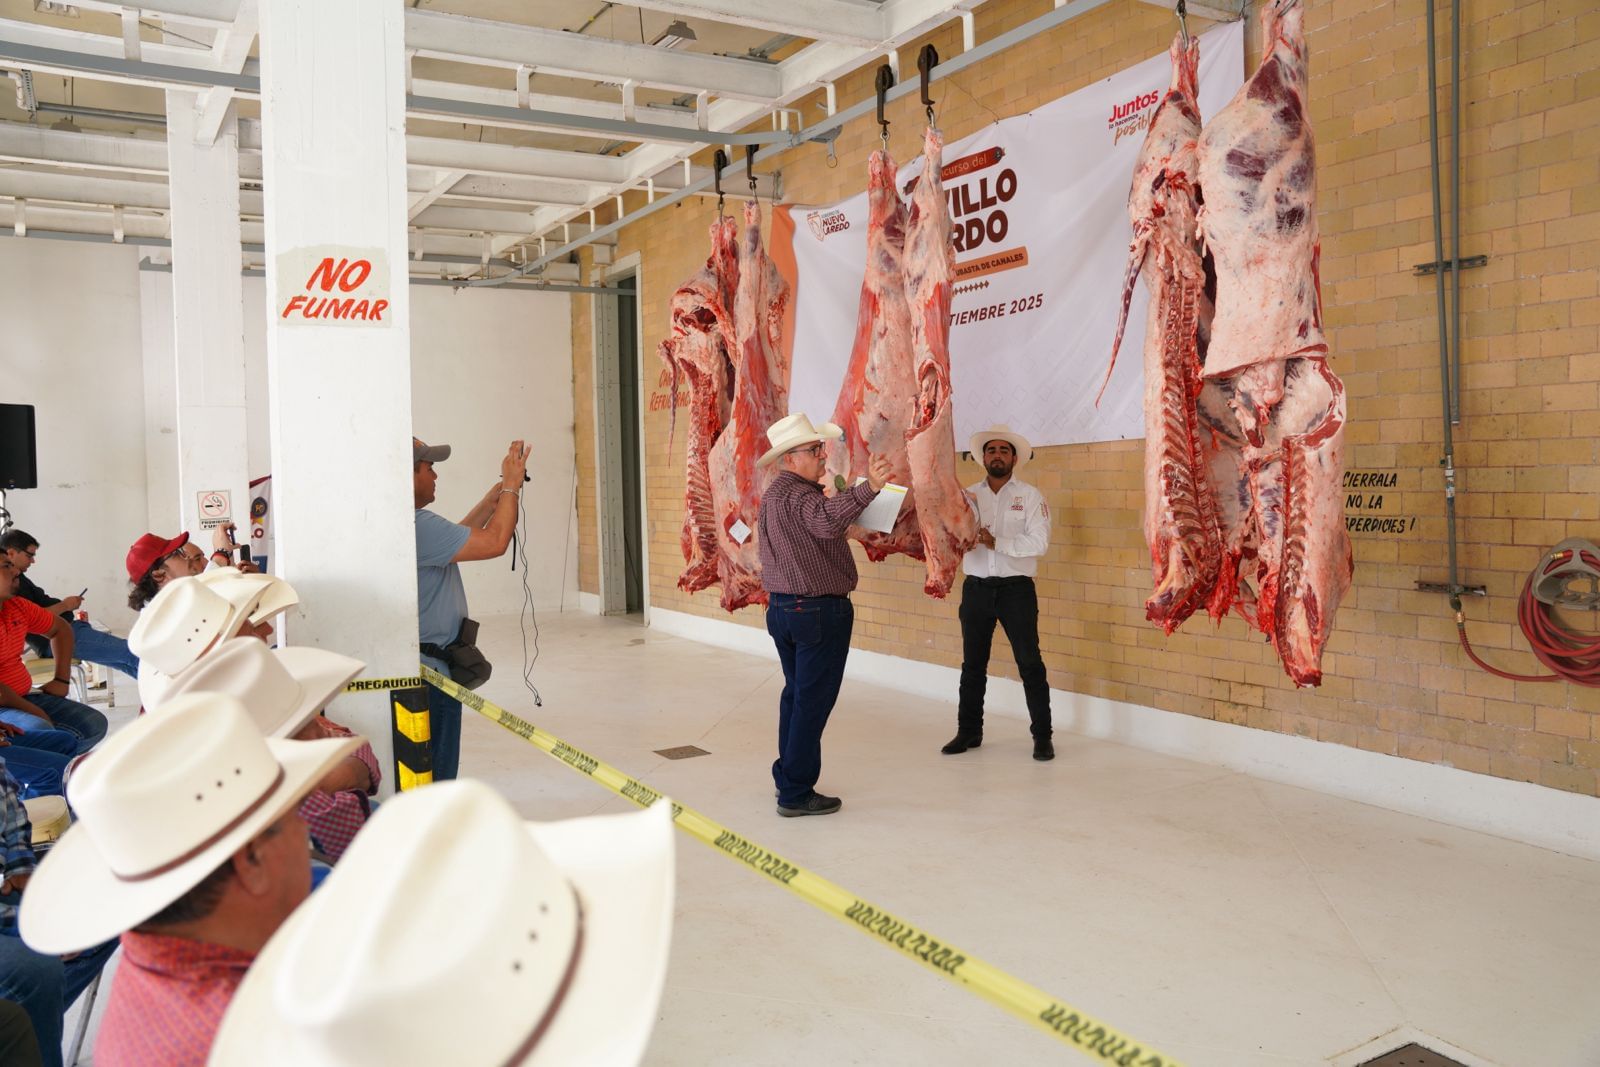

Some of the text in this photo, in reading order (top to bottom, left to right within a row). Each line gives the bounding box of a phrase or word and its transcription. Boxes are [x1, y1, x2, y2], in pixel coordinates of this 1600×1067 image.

[1108, 89, 1159, 123] Juntos
[1113, 107, 1152, 146] posibl
[971, 153, 988, 168] del
[822, 213, 846, 226] NUEVO
[822, 221, 850, 235] LAREDO
[952, 209, 1009, 253] RDO
[305, 257, 372, 293] NO
[955, 253, 1024, 276] UBASTA DE CANALES
[281, 295, 389, 321] FUMAR
[949, 293, 1044, 327] TIEMBRE 2025
[1342, 471, 1398, 488] CIERRALA
[1345, 494, 1383, 509] NO LA
[346, 676, 421, 692] PRECAUCIO
